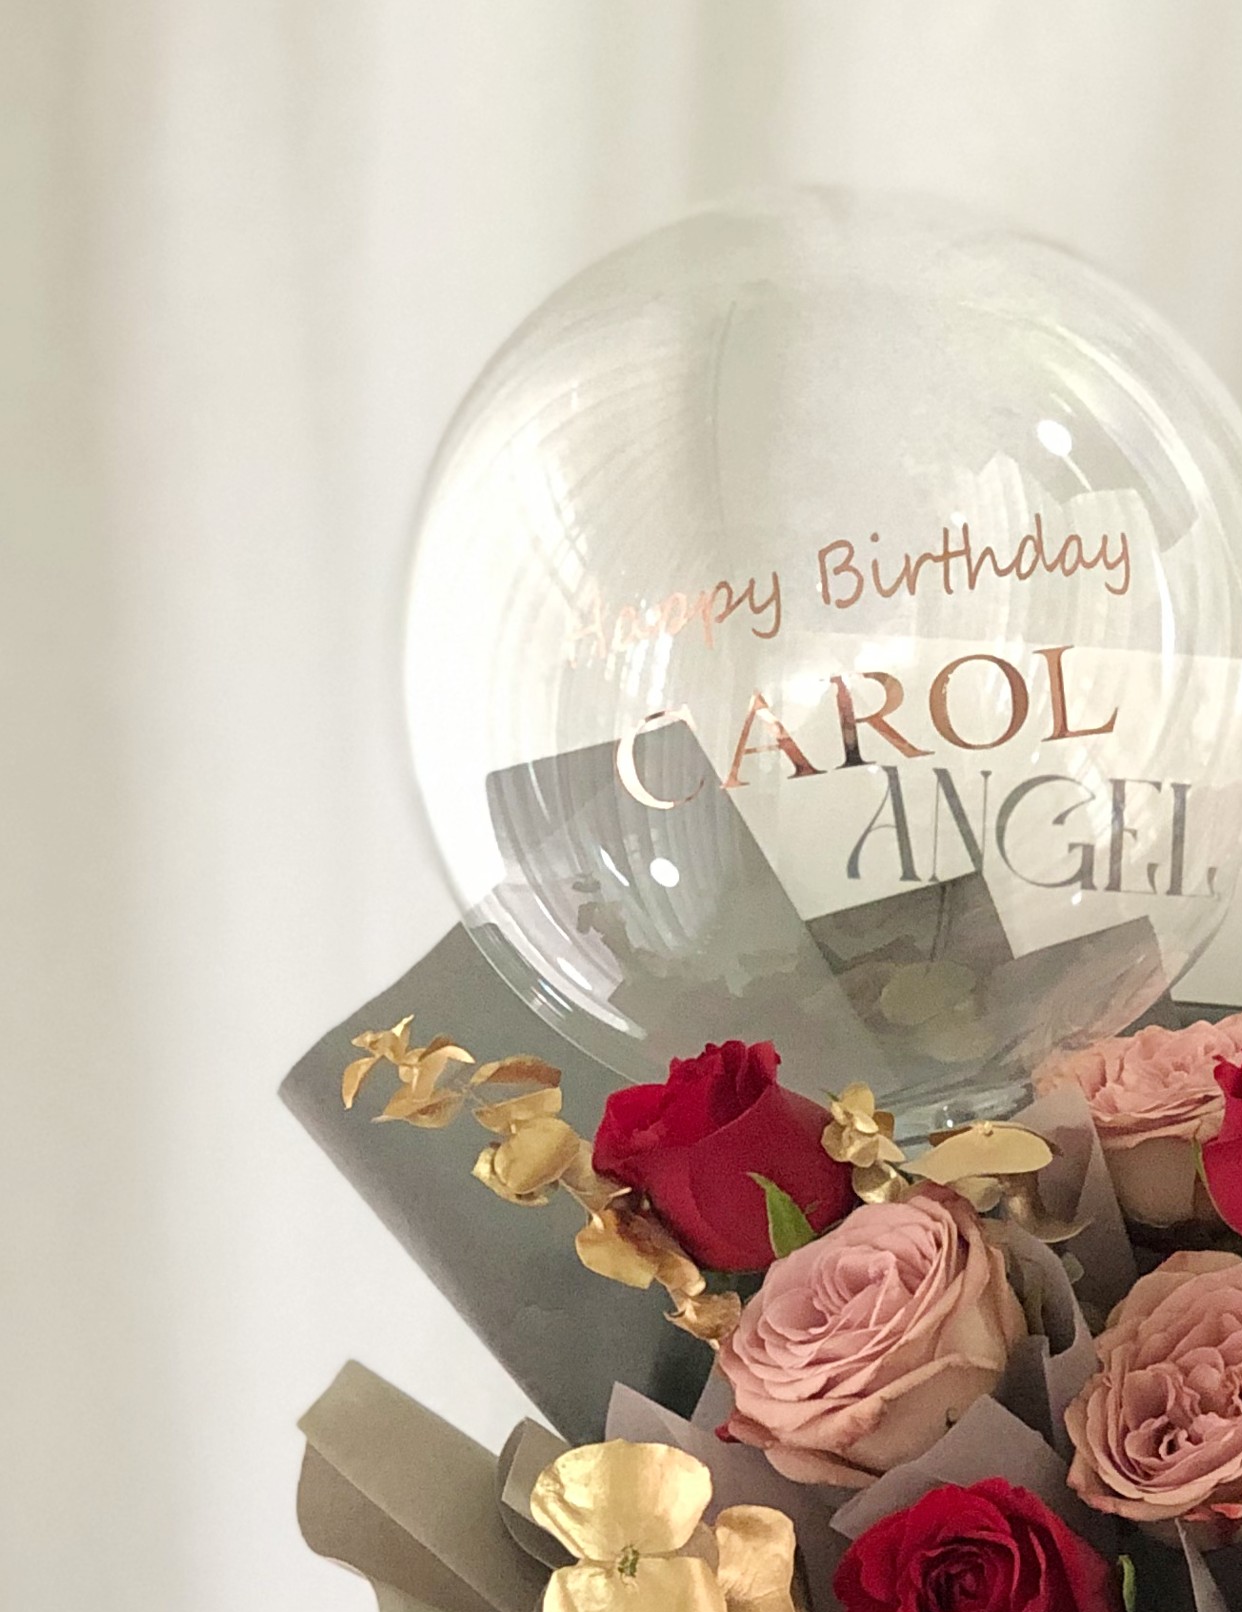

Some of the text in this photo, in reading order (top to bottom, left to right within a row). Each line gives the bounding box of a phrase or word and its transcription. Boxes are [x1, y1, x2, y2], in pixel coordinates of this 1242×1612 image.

[817, 512, 1130, 608] Birthday
[615, 645, 1120, 810] CAROL
[846, 765, 1222, 901] ANGEL
